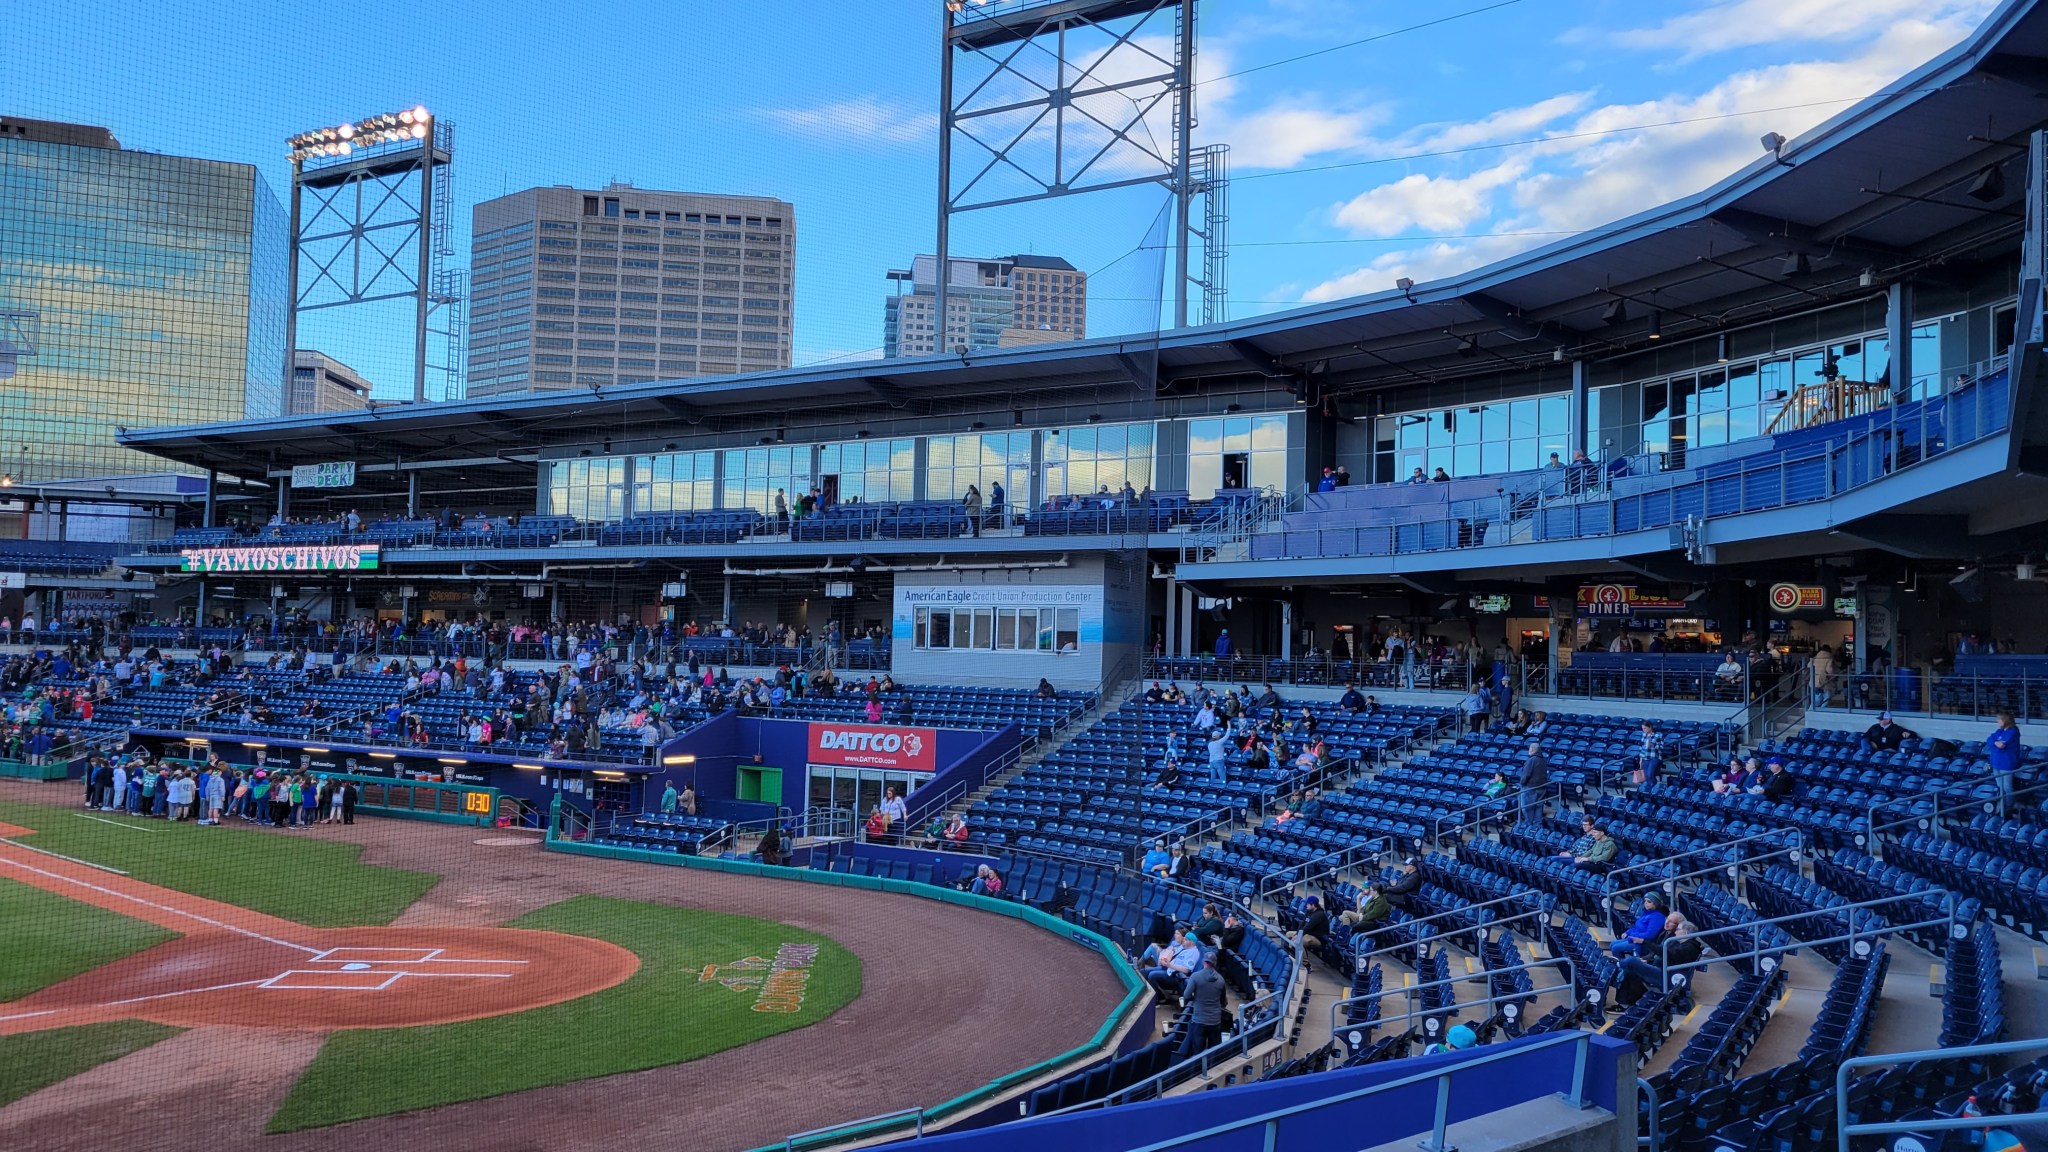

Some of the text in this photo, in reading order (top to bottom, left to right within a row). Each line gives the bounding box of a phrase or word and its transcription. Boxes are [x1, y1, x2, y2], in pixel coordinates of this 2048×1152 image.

[318, 462, 354, 474] PARTY
[317, 474, 353, 486] DECK!
[187, 546, 361, 571] #VAMOSCHIVOS
[904, 588, 1092, 603] American Eagle Credit Union Production Center
[1589, 603, 1630, 614] DINER
[820, 731, 901, 753] DATTCO
[845, 756, 896, 765] www.DATTCO.com
[144, 779, 155, 788] 25
